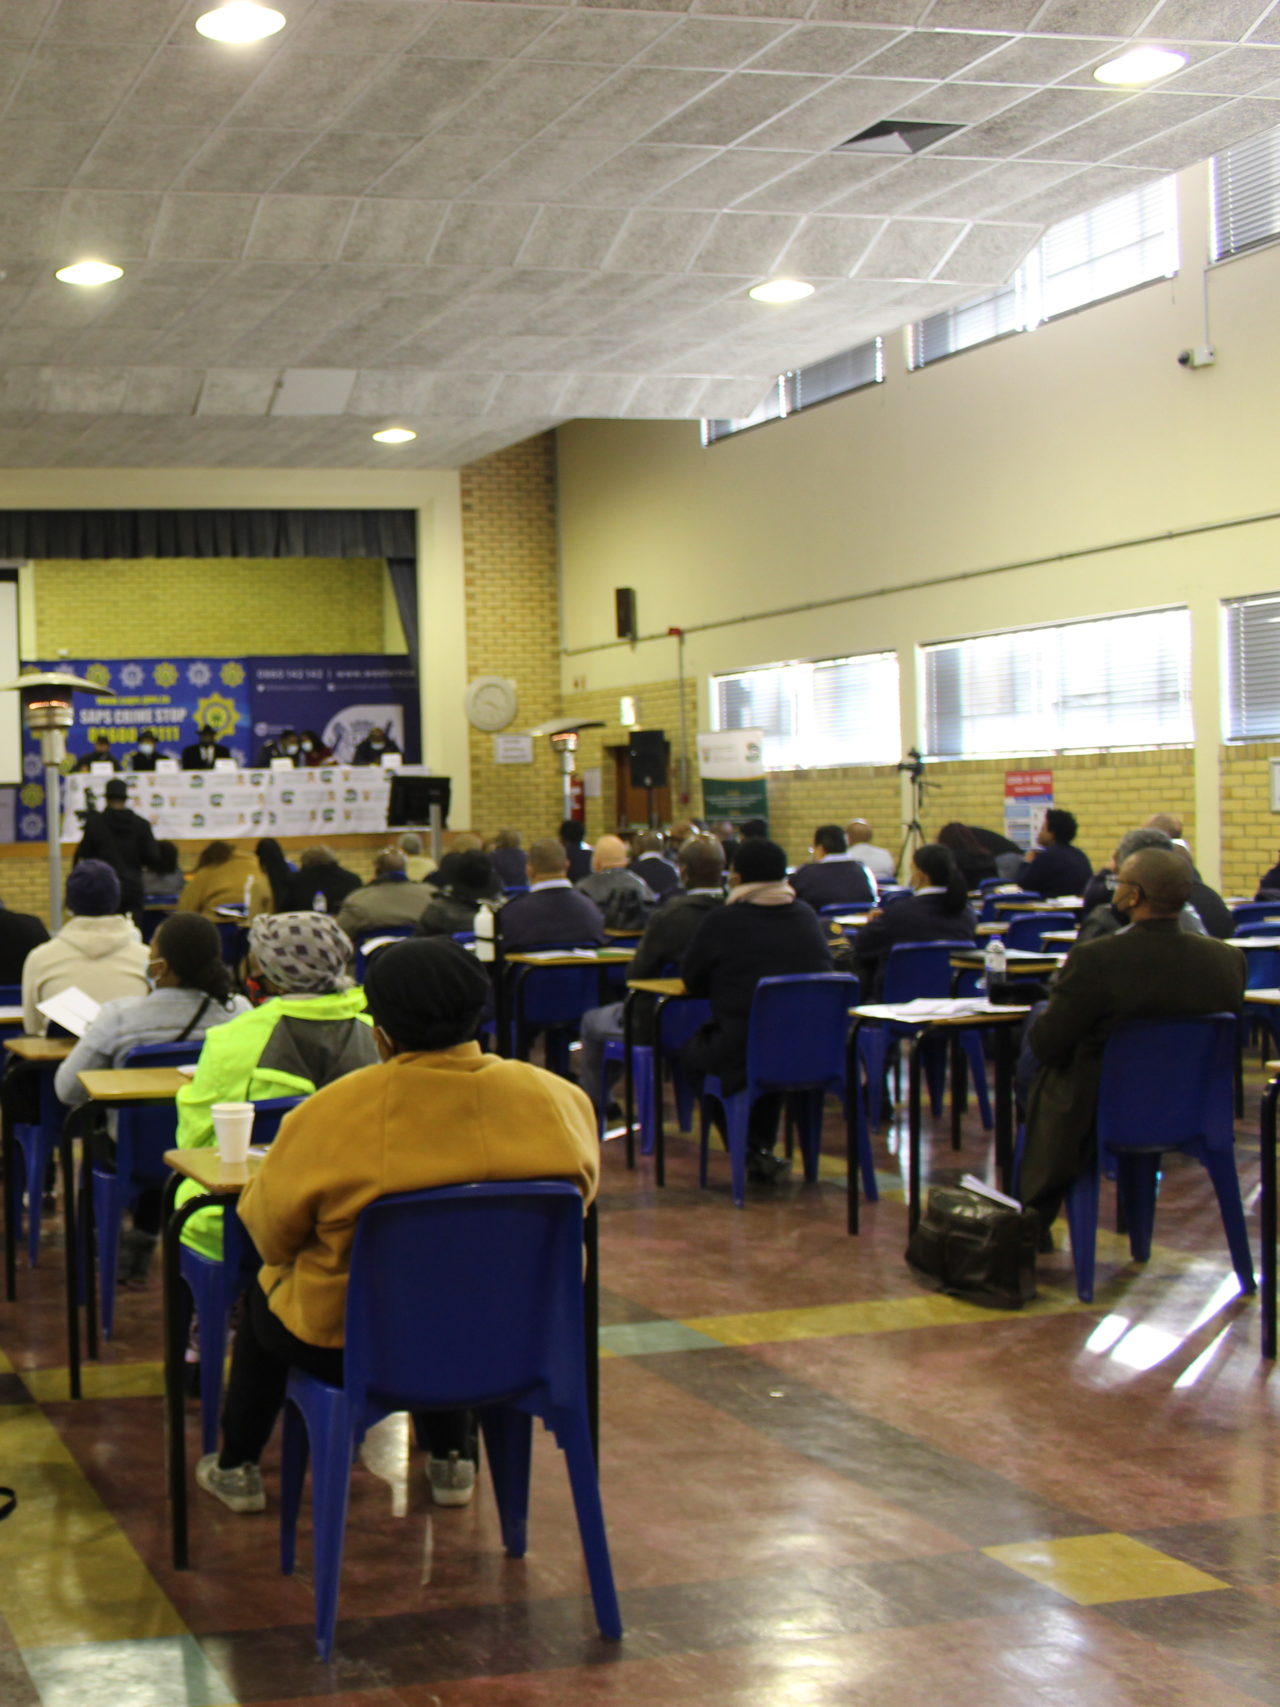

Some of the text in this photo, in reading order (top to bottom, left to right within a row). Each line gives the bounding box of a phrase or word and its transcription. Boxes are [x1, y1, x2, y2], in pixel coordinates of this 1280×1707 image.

[80, 706, 187, 725] SAPS CRIME STOP
